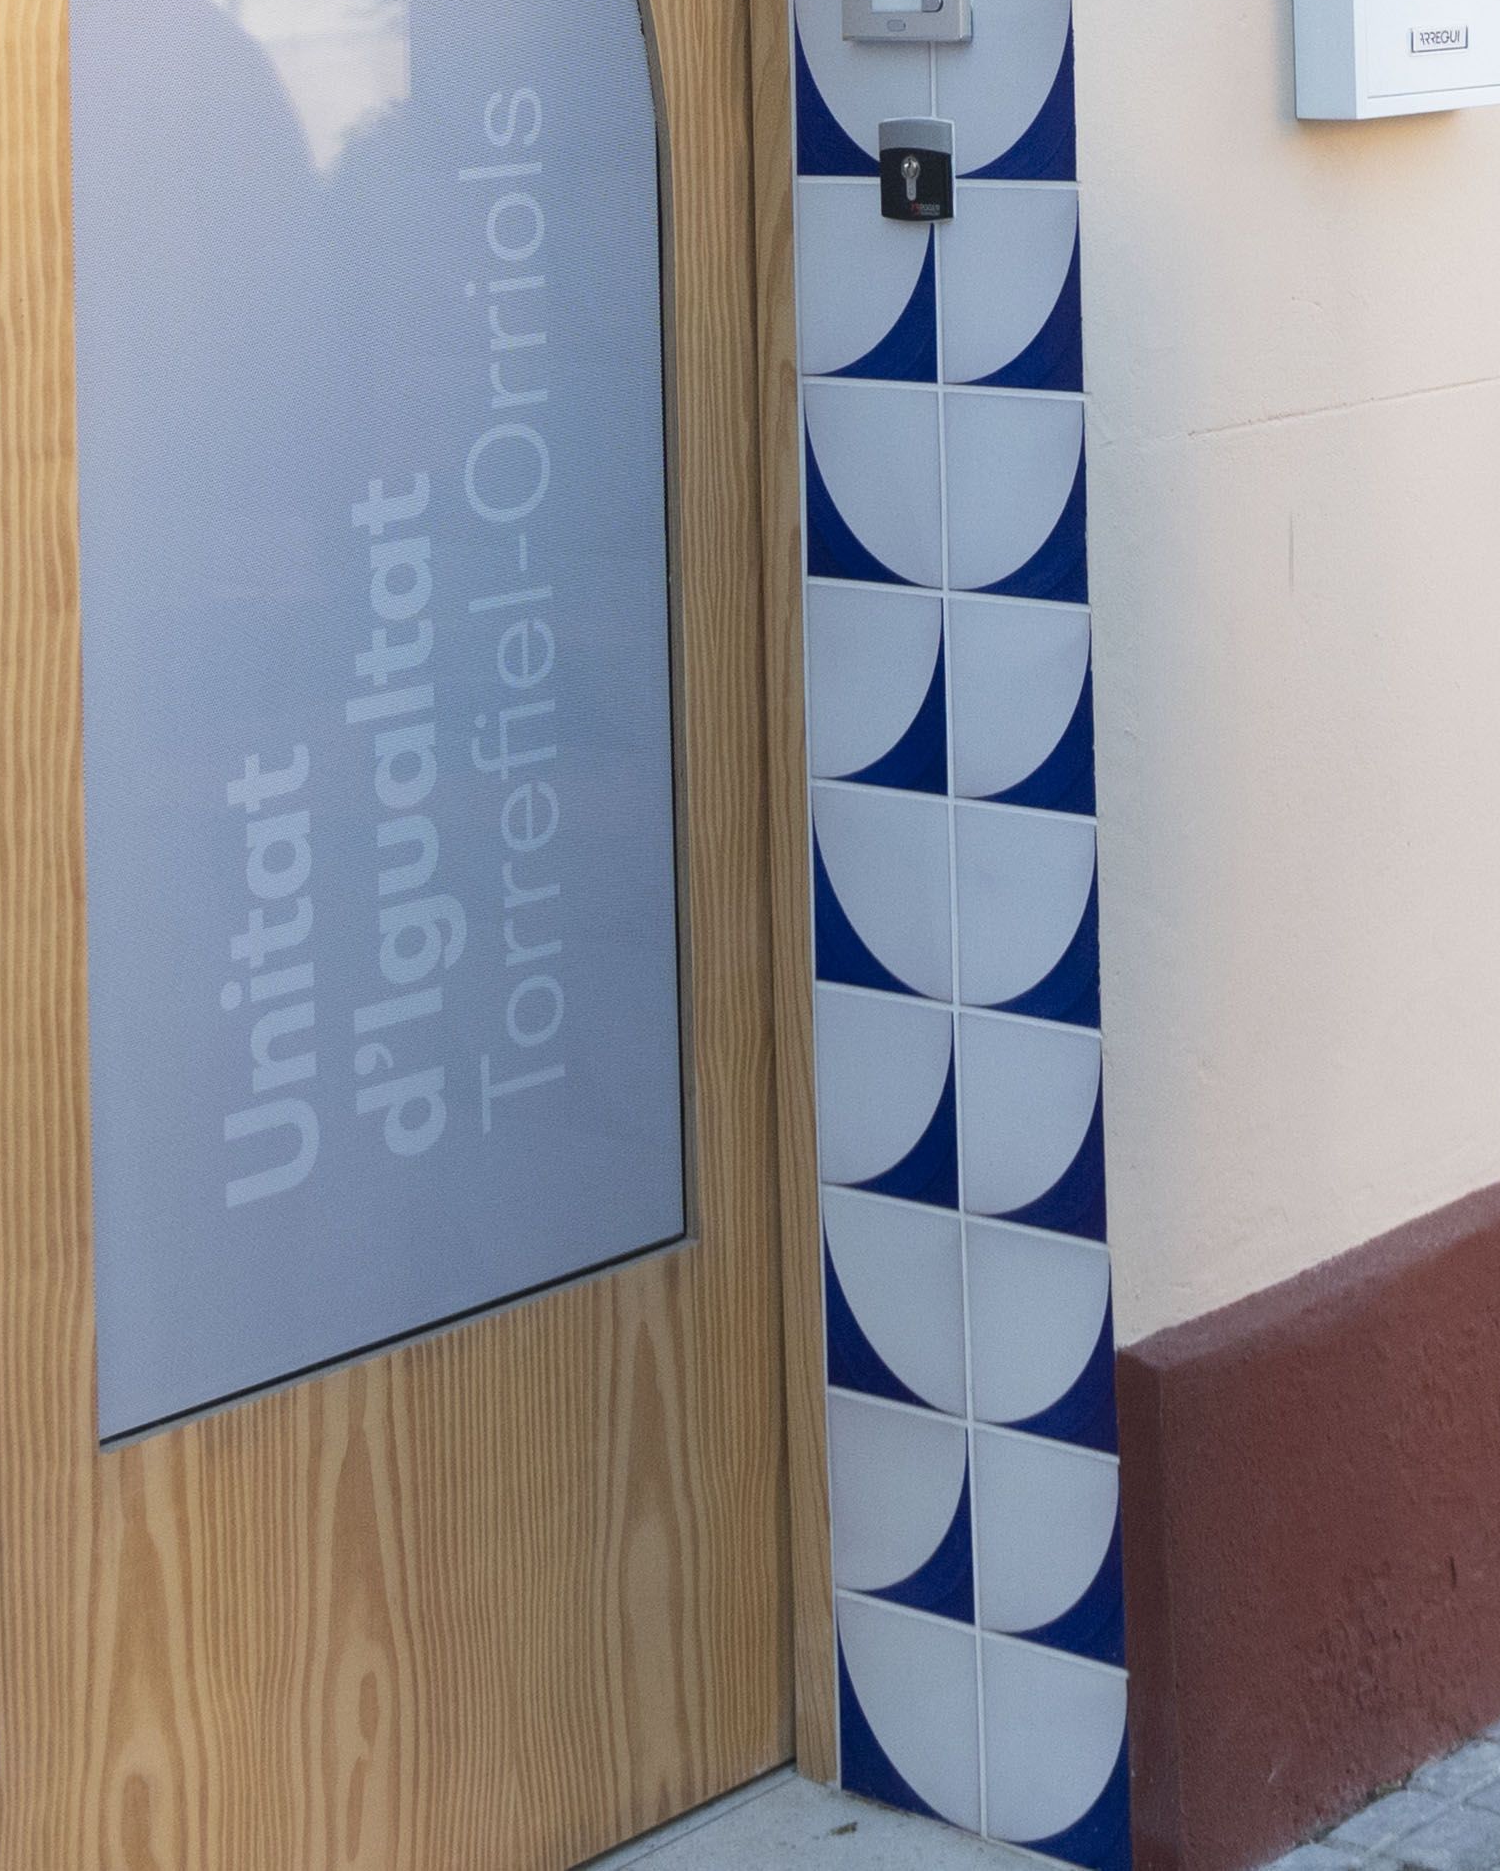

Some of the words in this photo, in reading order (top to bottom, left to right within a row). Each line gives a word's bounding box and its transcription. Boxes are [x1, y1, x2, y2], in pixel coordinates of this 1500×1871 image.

[1419, 29, 1461, 46] ARREGUI
[346, 470, 468, 1158] d’Igualtat
[457, 86, 567, 1137] Torrefiel-Orriols
[220, 742, 322, 1210] Unitat
